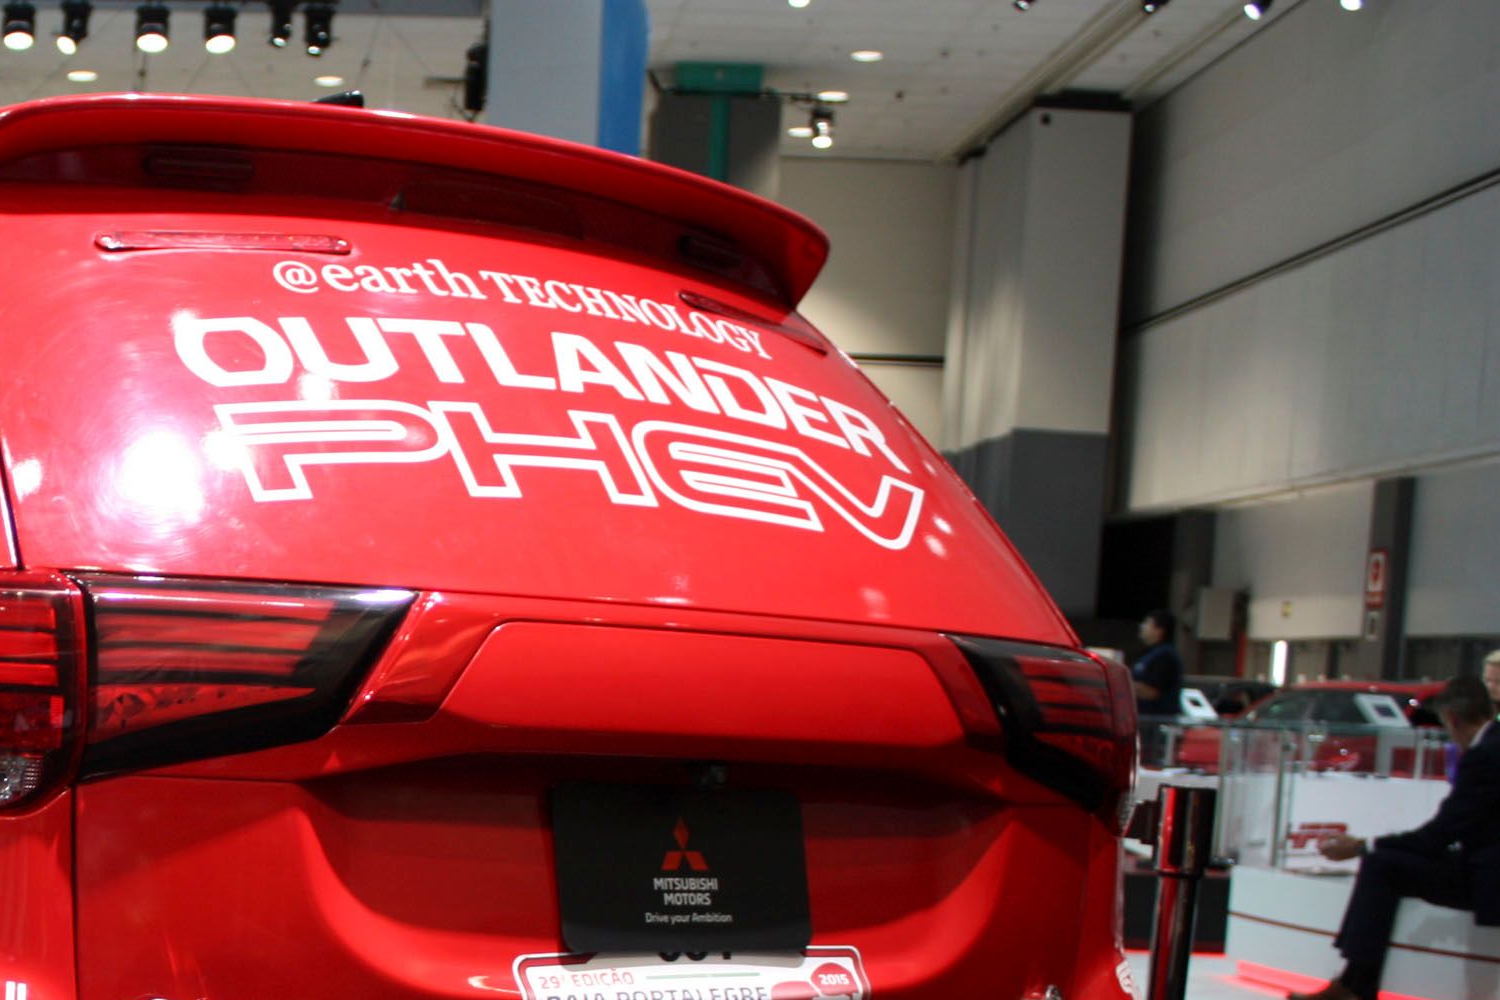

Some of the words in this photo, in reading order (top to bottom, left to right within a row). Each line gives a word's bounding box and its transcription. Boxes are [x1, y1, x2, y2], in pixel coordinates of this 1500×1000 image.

[272, 258, 488, 301] @earth
[479, 270, 774, 360] TECHNOLOGY
[174, 316, 912, 474] OUTLANDER
[213, 399, 925, 550] PHEV
[653, 877, 718, 891] MITSUBISHI
[663, 892, 712, 906] MOTORS
[644, 912, 669, 923] Drive
[670, 914, 690, 925] your
[691, 912, 733, 923] Ambition
[818, 973, 850, 985] 2015
